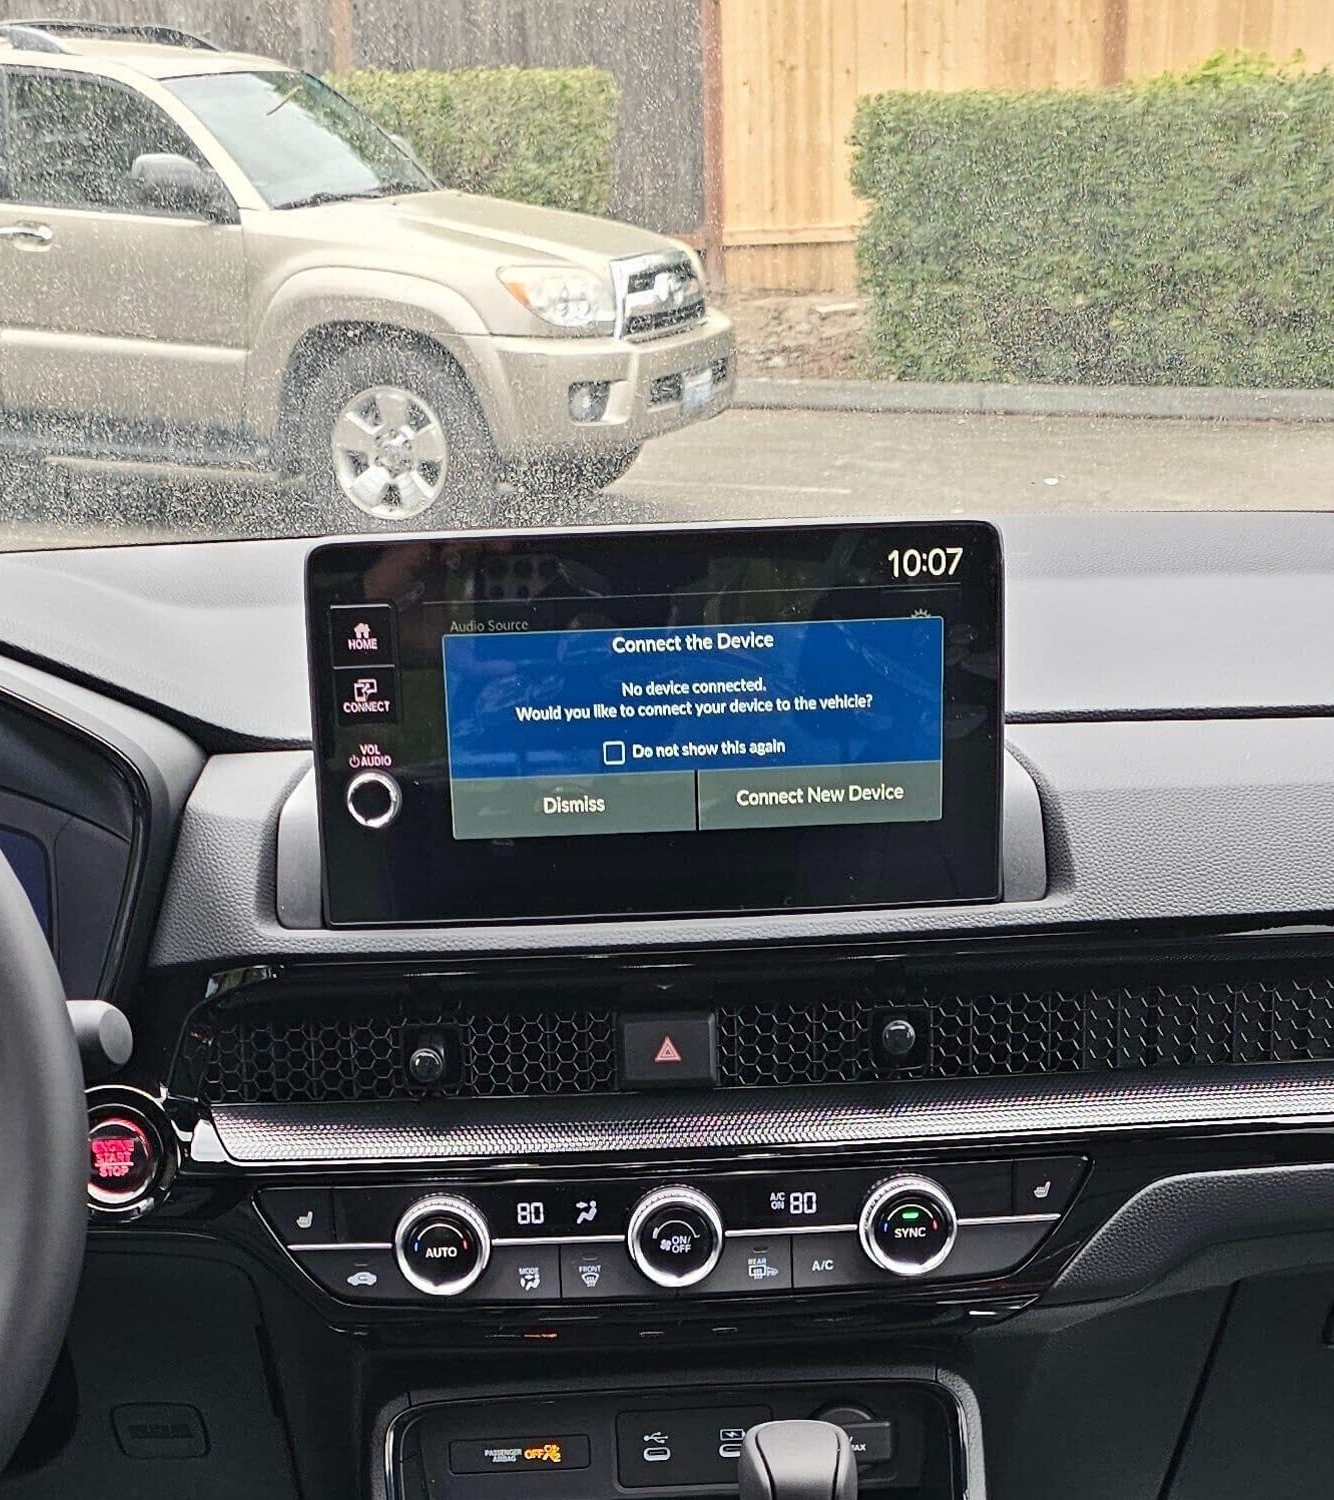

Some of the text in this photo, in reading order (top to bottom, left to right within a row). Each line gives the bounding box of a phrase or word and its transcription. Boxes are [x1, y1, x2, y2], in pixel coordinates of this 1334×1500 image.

[887, 547, 964, 579] 10:07
[450, 619, 528, 633] Audio Source
[347, 638, 378, 650] HOME
[612, 632, 774, 654] Connect the Device
[622, 677, 767, 697] No device connected.
[343, 701, 390, 713] CONNECT
[516, 693, 873, 722] Would you like to connect your device to the vehicle?
[359, 744, 380, 756] VOL
[632, 739, 785, 759] Do not show this again
[361, 755, 391, 767] AUDIO
[736, 783, 905, 807] Connect New Device
[543, 796, 605, 815] Dismiss
[95, 1152, 131, 1163] START
[99, 1166, 129, 1177] STOP
[769, 1192, 817, 1214] A/C 80
[771, 1201, 784, 1210] ON
[517, 1202, 544, 1225] 80
[894, 1227, 926, 1238] SYNC
[425, 1247, 458, 1259] AUTO
[671, 1244, 691, 1254] OFF
[579, 1265, 601, 1273] FRONT
[812, 1260, 834, 1271] A/C
[484, 1448, 544, 1460] PASSENGER OFF
